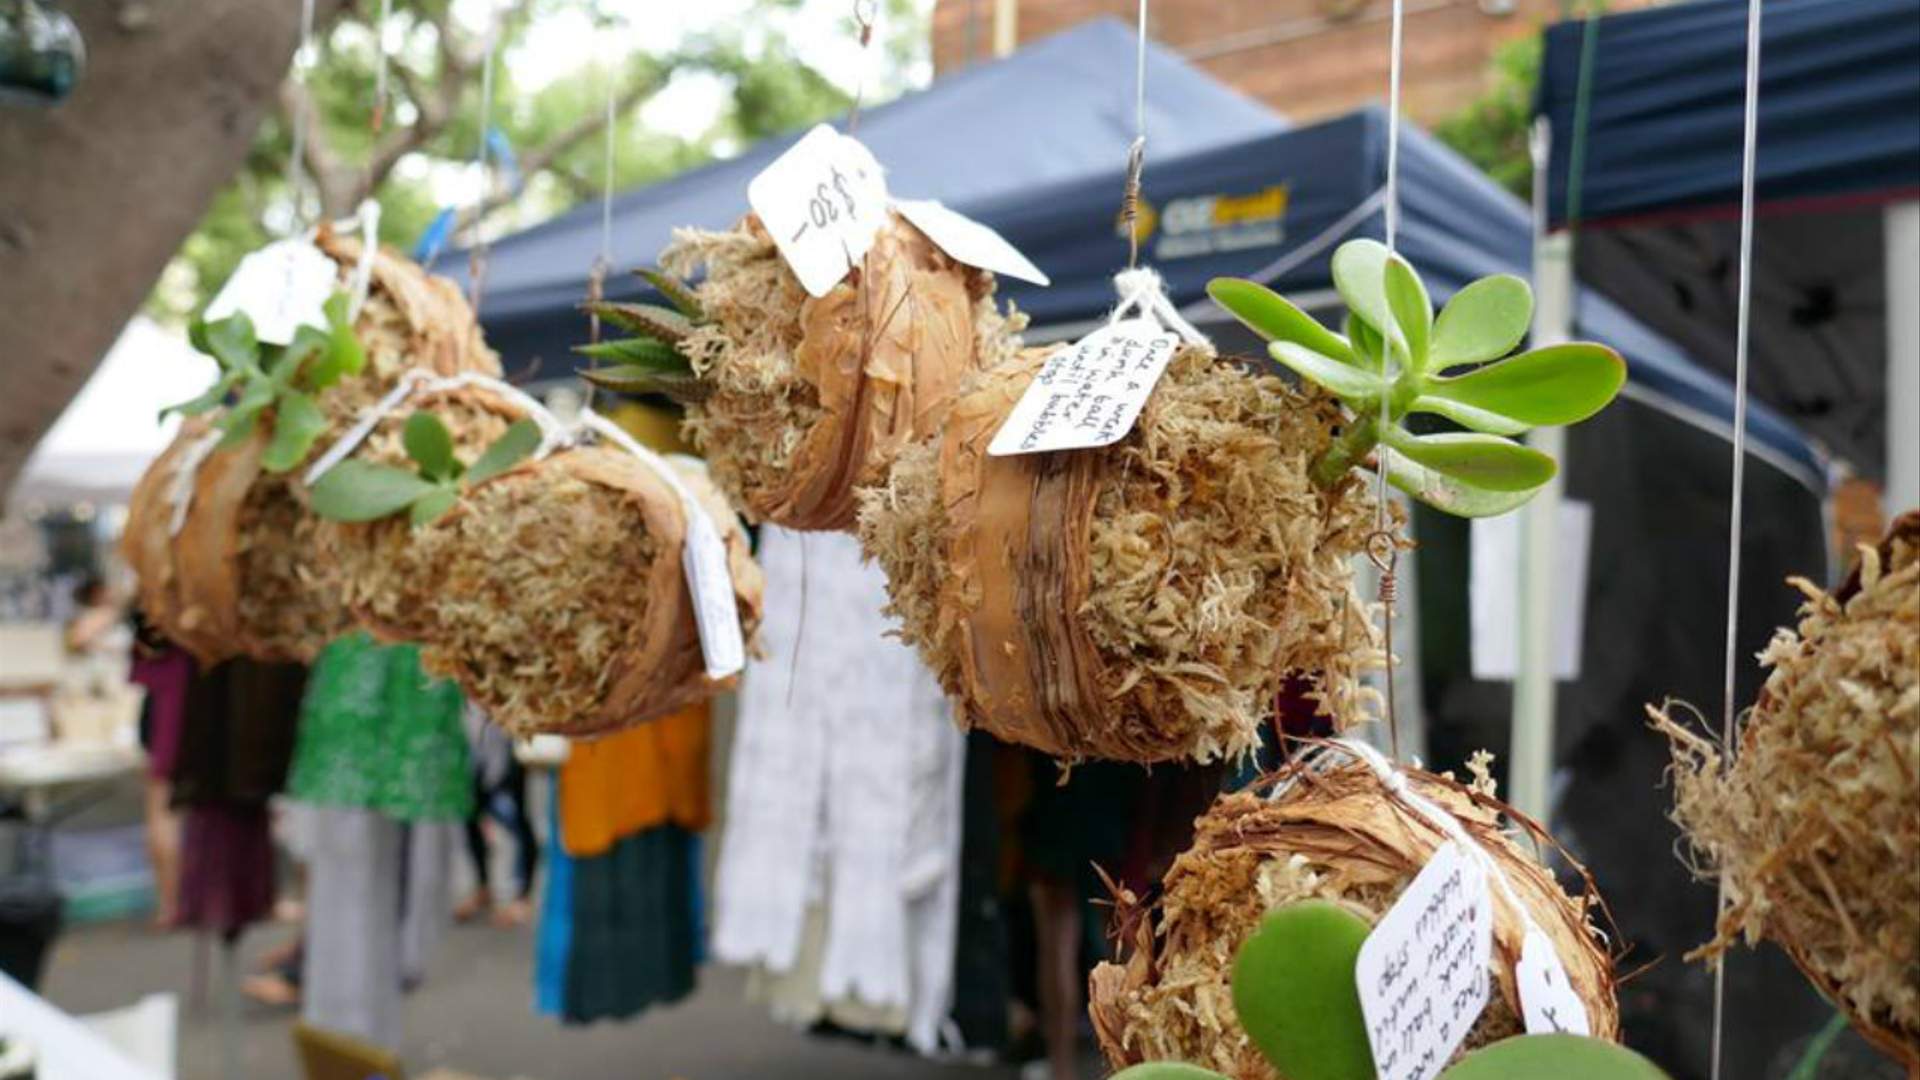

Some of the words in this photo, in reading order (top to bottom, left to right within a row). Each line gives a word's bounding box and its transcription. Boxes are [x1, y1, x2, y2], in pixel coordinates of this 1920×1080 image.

[1062, 368, 1103, 421] water
[1125, 380, 1141, 392] a
[1073, 394, 1113, 430] ball
[1094, 402, 1129, 442] week
[1401, 996, 1433, 1055] ball
